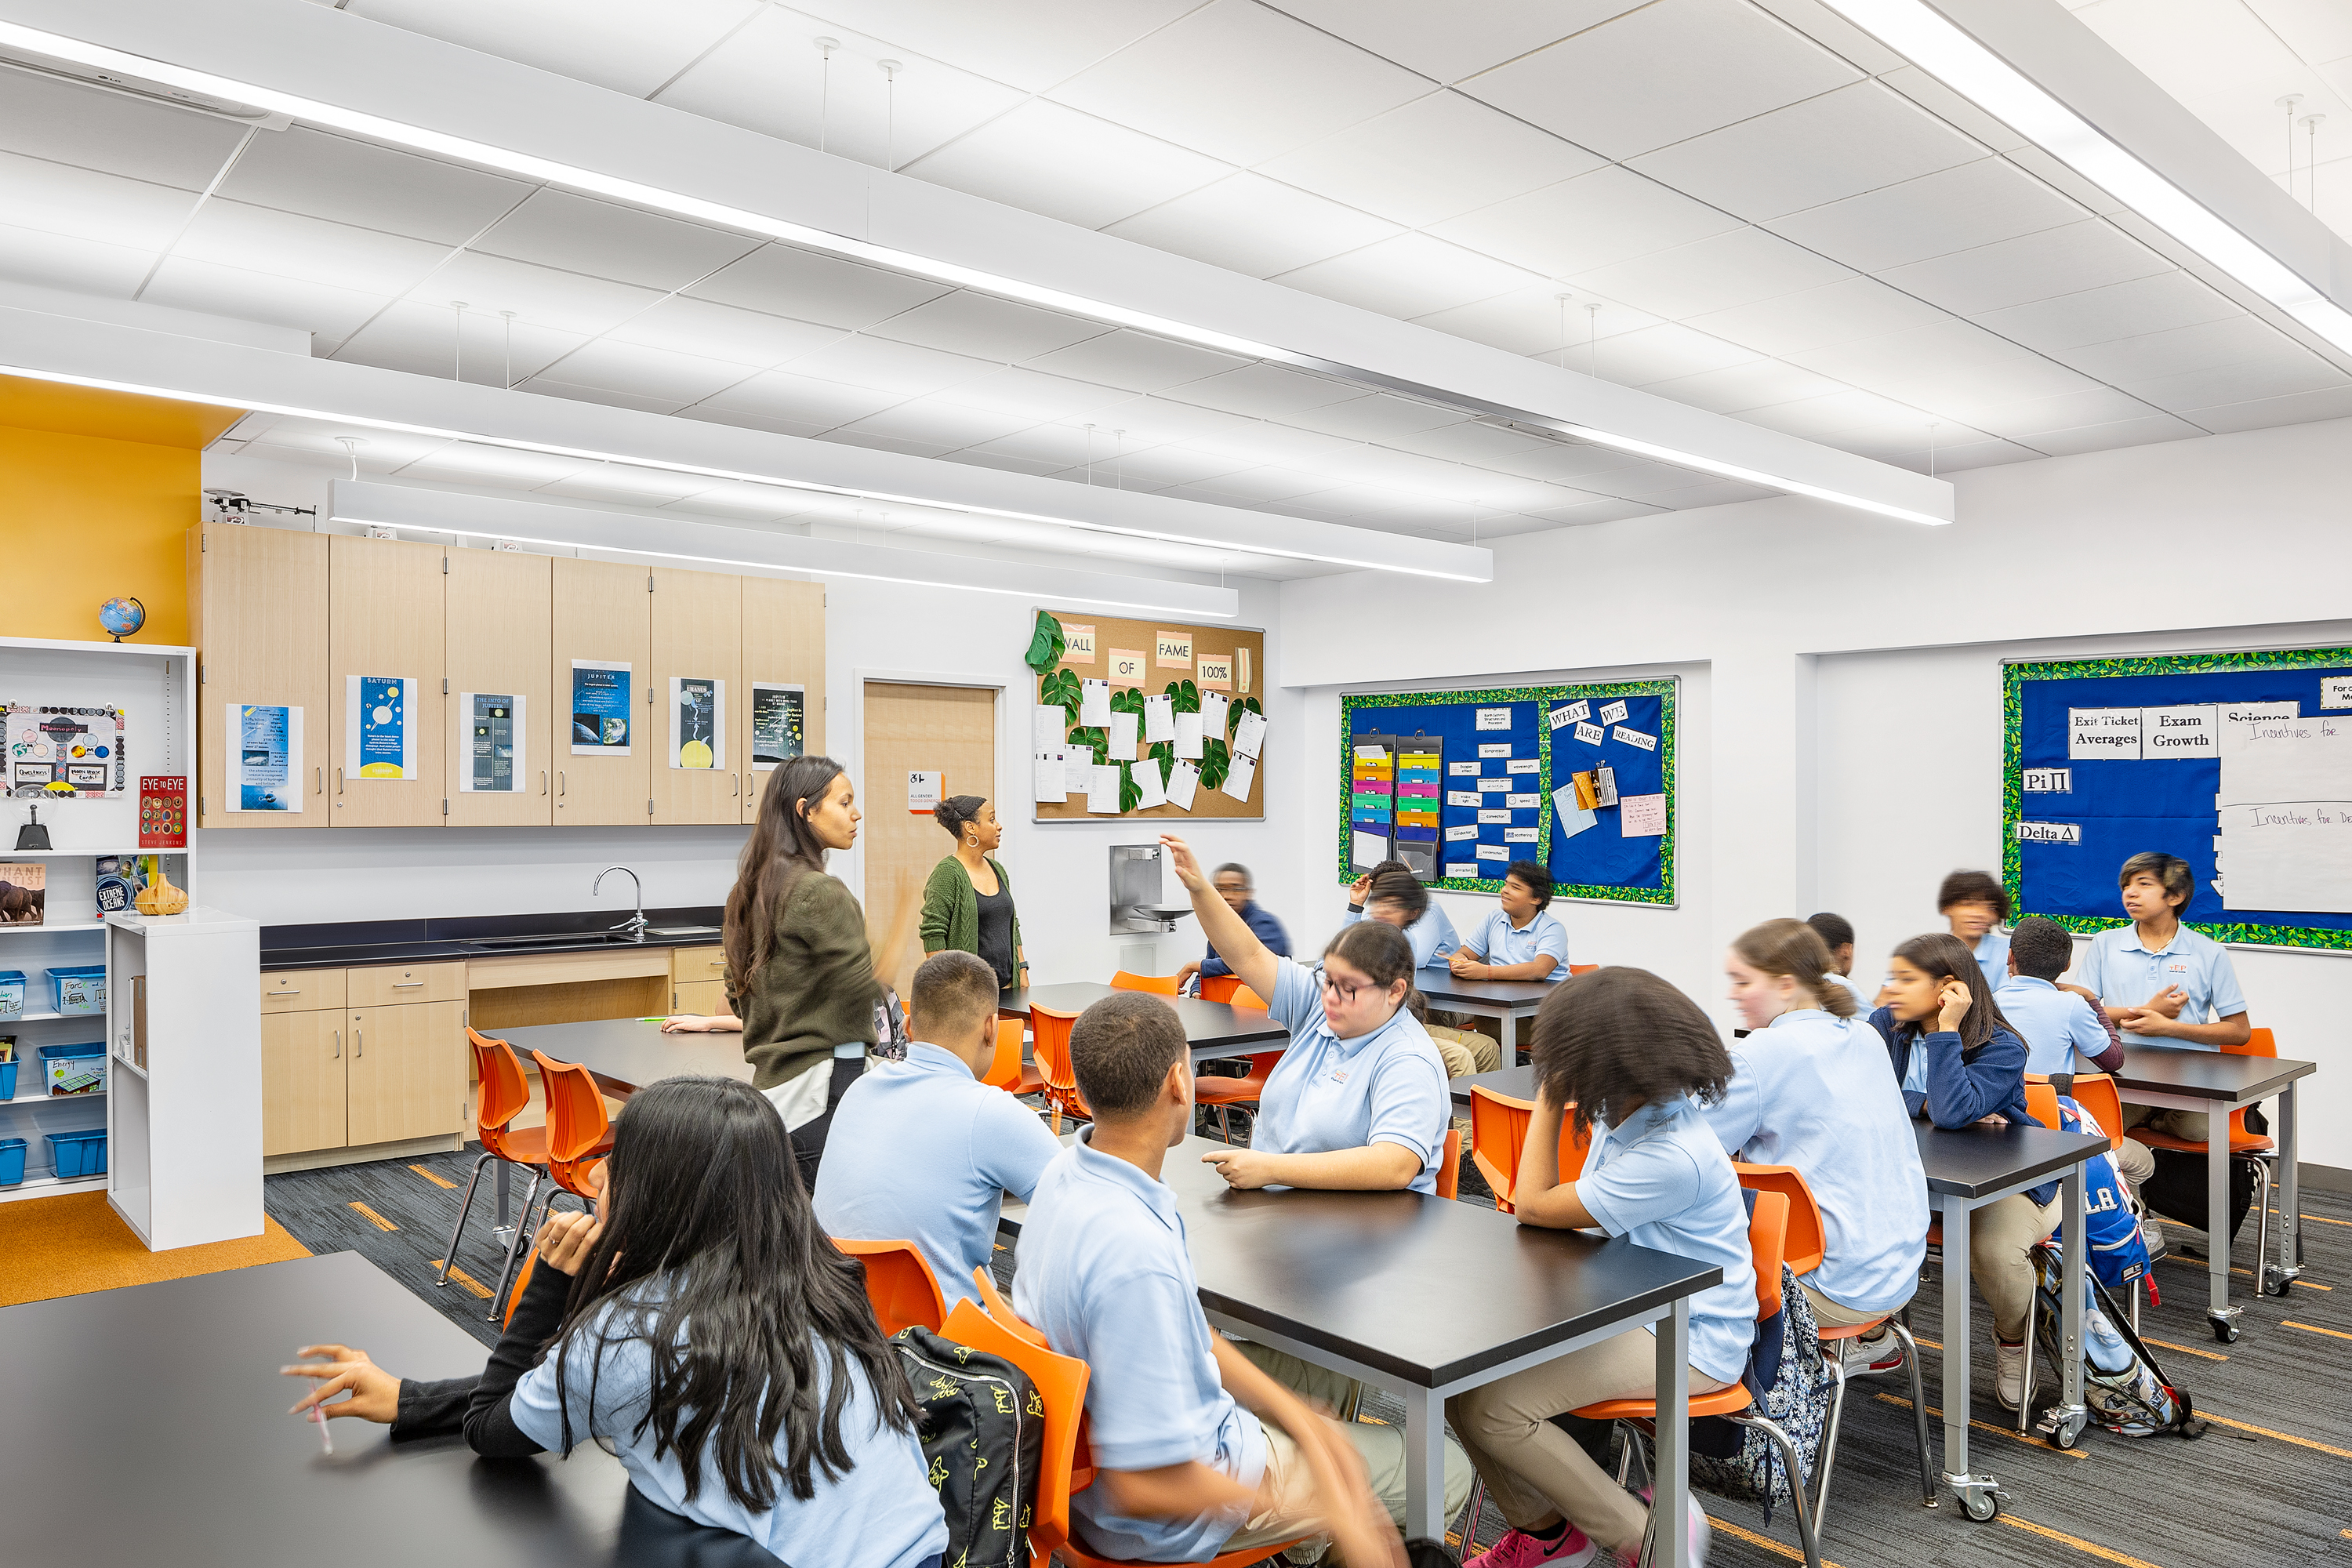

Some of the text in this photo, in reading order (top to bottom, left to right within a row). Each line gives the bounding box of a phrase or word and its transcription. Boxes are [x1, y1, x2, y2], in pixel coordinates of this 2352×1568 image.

[1119, 662, 1134, 674] OF
[1159, 644, 1189, 658] FAME
[1202, 666, 1227, 679] 100%
[1552, 704, 1588, 726] WHAT
[2074, 716, 2139, 727] Exit Ticket
[2159, 715, 2202, 728] Exam
[41, 724, 82, 733] Moonopoly
[1577, 706, 1625, 741] ARE WE
[2246, 722, 2312, 741] Incentives
[1615, 730, 1654, 748] READING
[2075, 733, 2137, 747] Averages
[2153, 735, 2210, 747] Growth
[143, 779, 159, 790] EYE
[167, 779, 184, 790] EYE
[2027, 775, 2046, 789] Pi
[2249, 807, 2312, 827] Incentives
[2019, 826, 2058, 840] Delta
[0, 867, 42, 876] HANT
[99, 887, 125, 902] EXTREME
[103, 896, 125, 911] OCEANS
[53, 1060, 74, 1070] Energy
